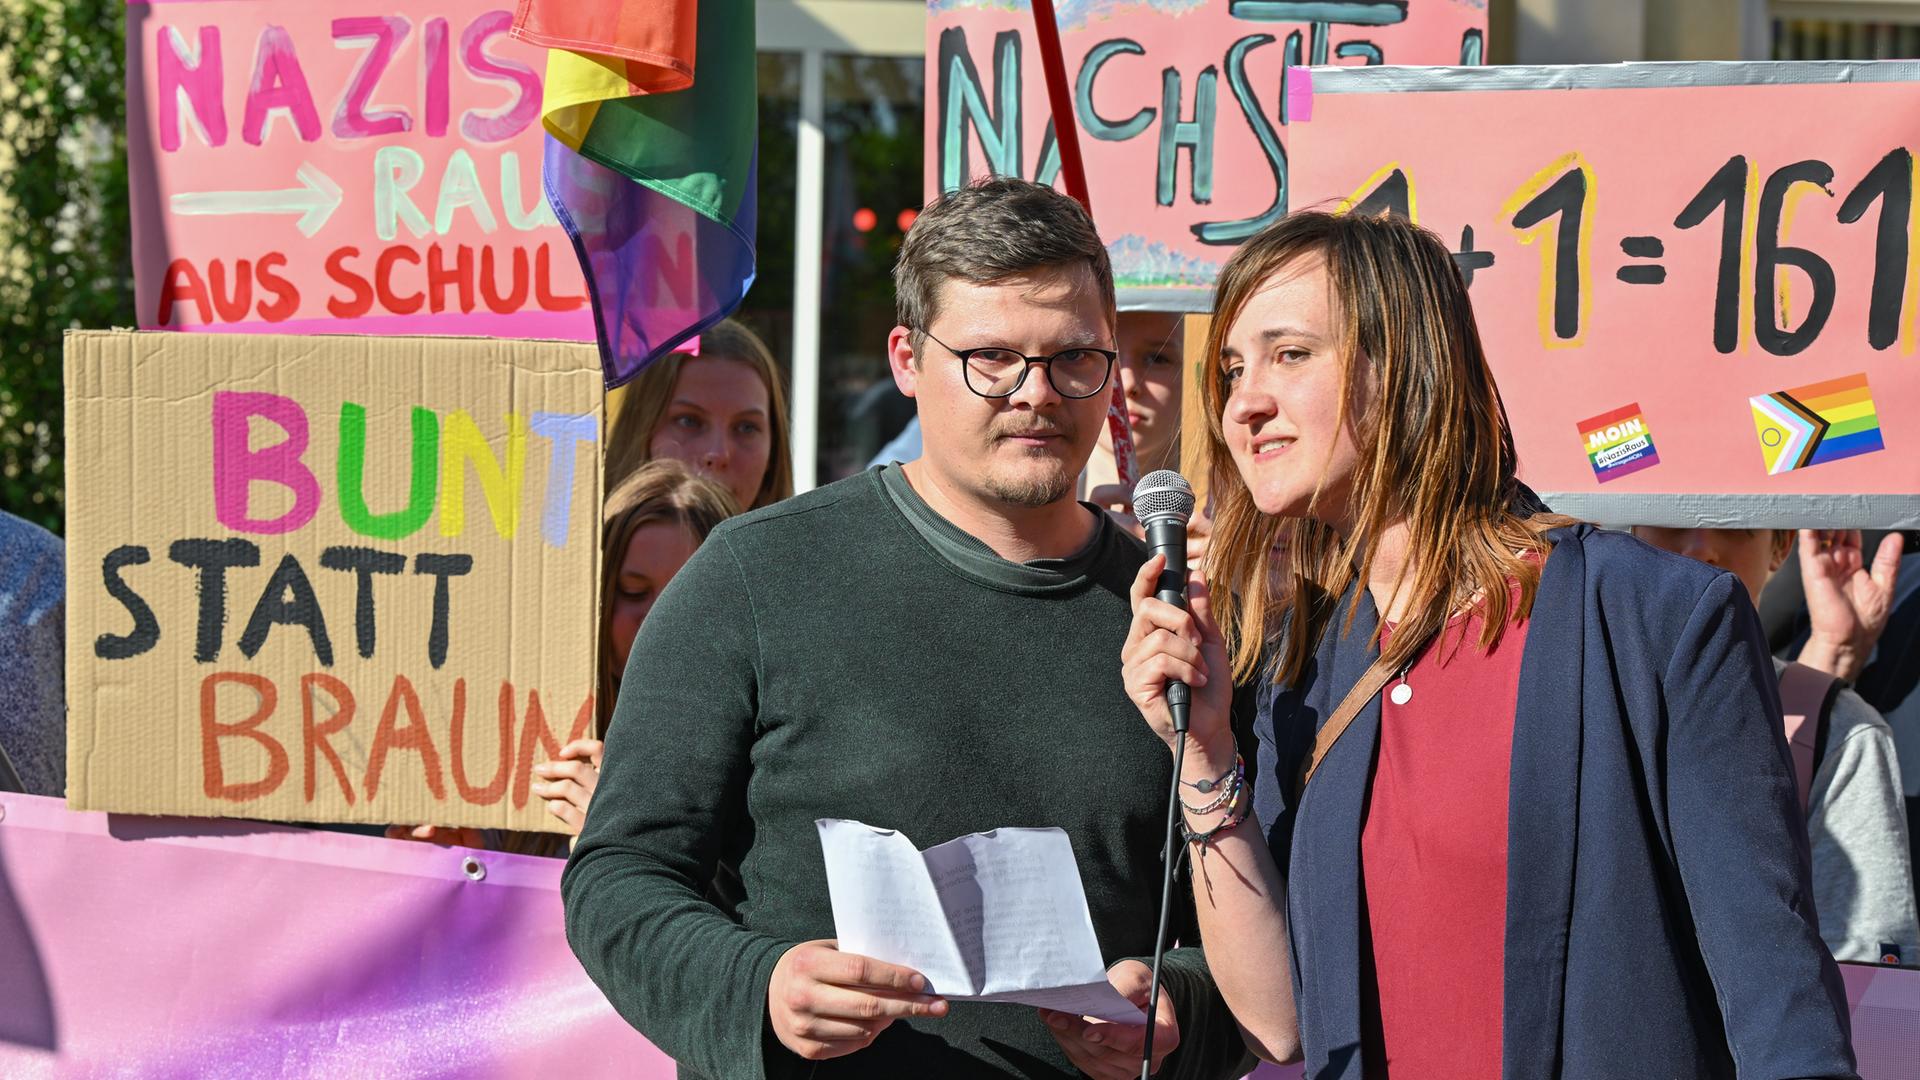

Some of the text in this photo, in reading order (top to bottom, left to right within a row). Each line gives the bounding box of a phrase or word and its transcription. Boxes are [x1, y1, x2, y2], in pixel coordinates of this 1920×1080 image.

[157, 10, 544, 152] NAZIS
[157, 251, 300, 326] AUS
[211, 389, 598, 548] BUNT
[1589, 418, 1642, 448] MOIN
[1598, 440, 1646, 464] #NazisRaus
[94, 537, 474, 669] STATT
